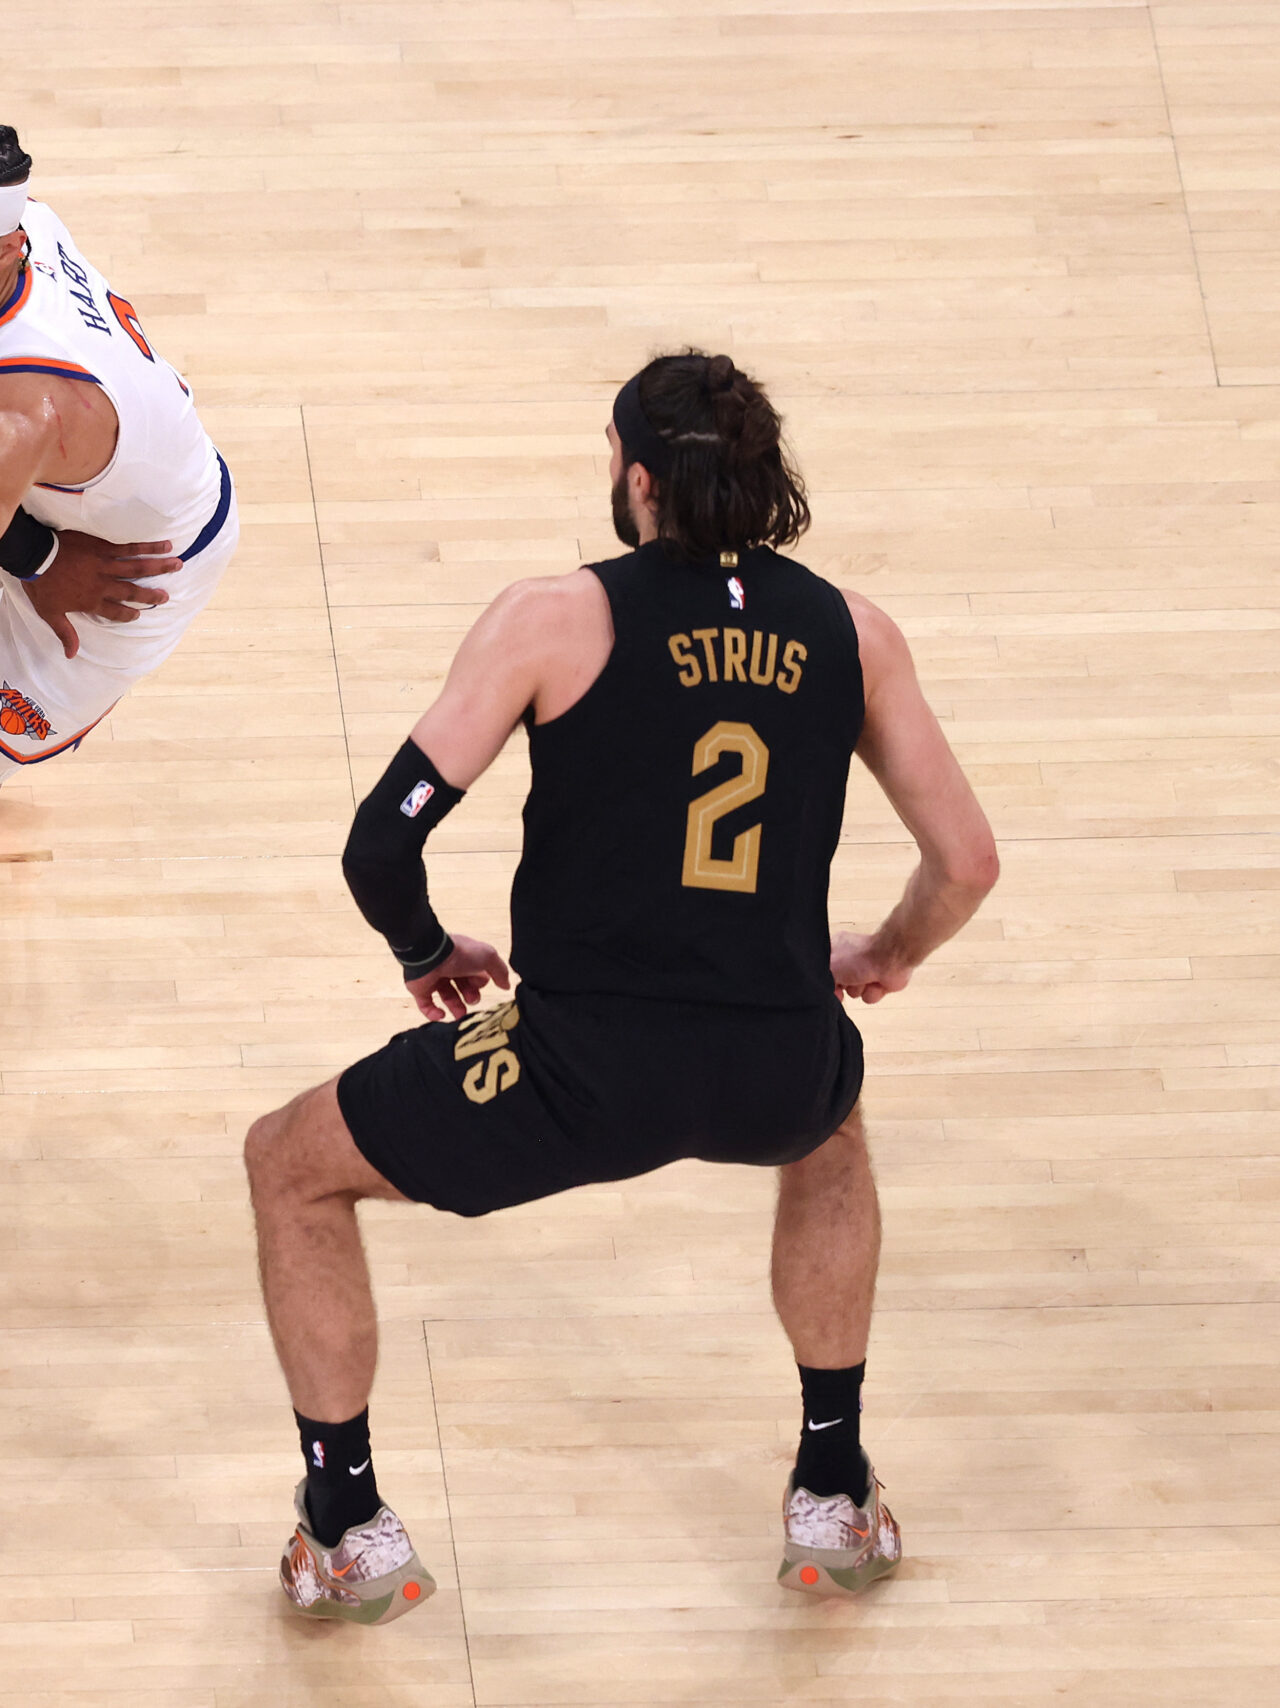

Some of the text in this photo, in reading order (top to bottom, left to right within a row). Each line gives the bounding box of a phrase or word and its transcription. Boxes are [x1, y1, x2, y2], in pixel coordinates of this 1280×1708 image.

[57, 241, 112, 336] HART
[668, 627, 808, 694] STRUS
[681, 720, 770, 893] 2
